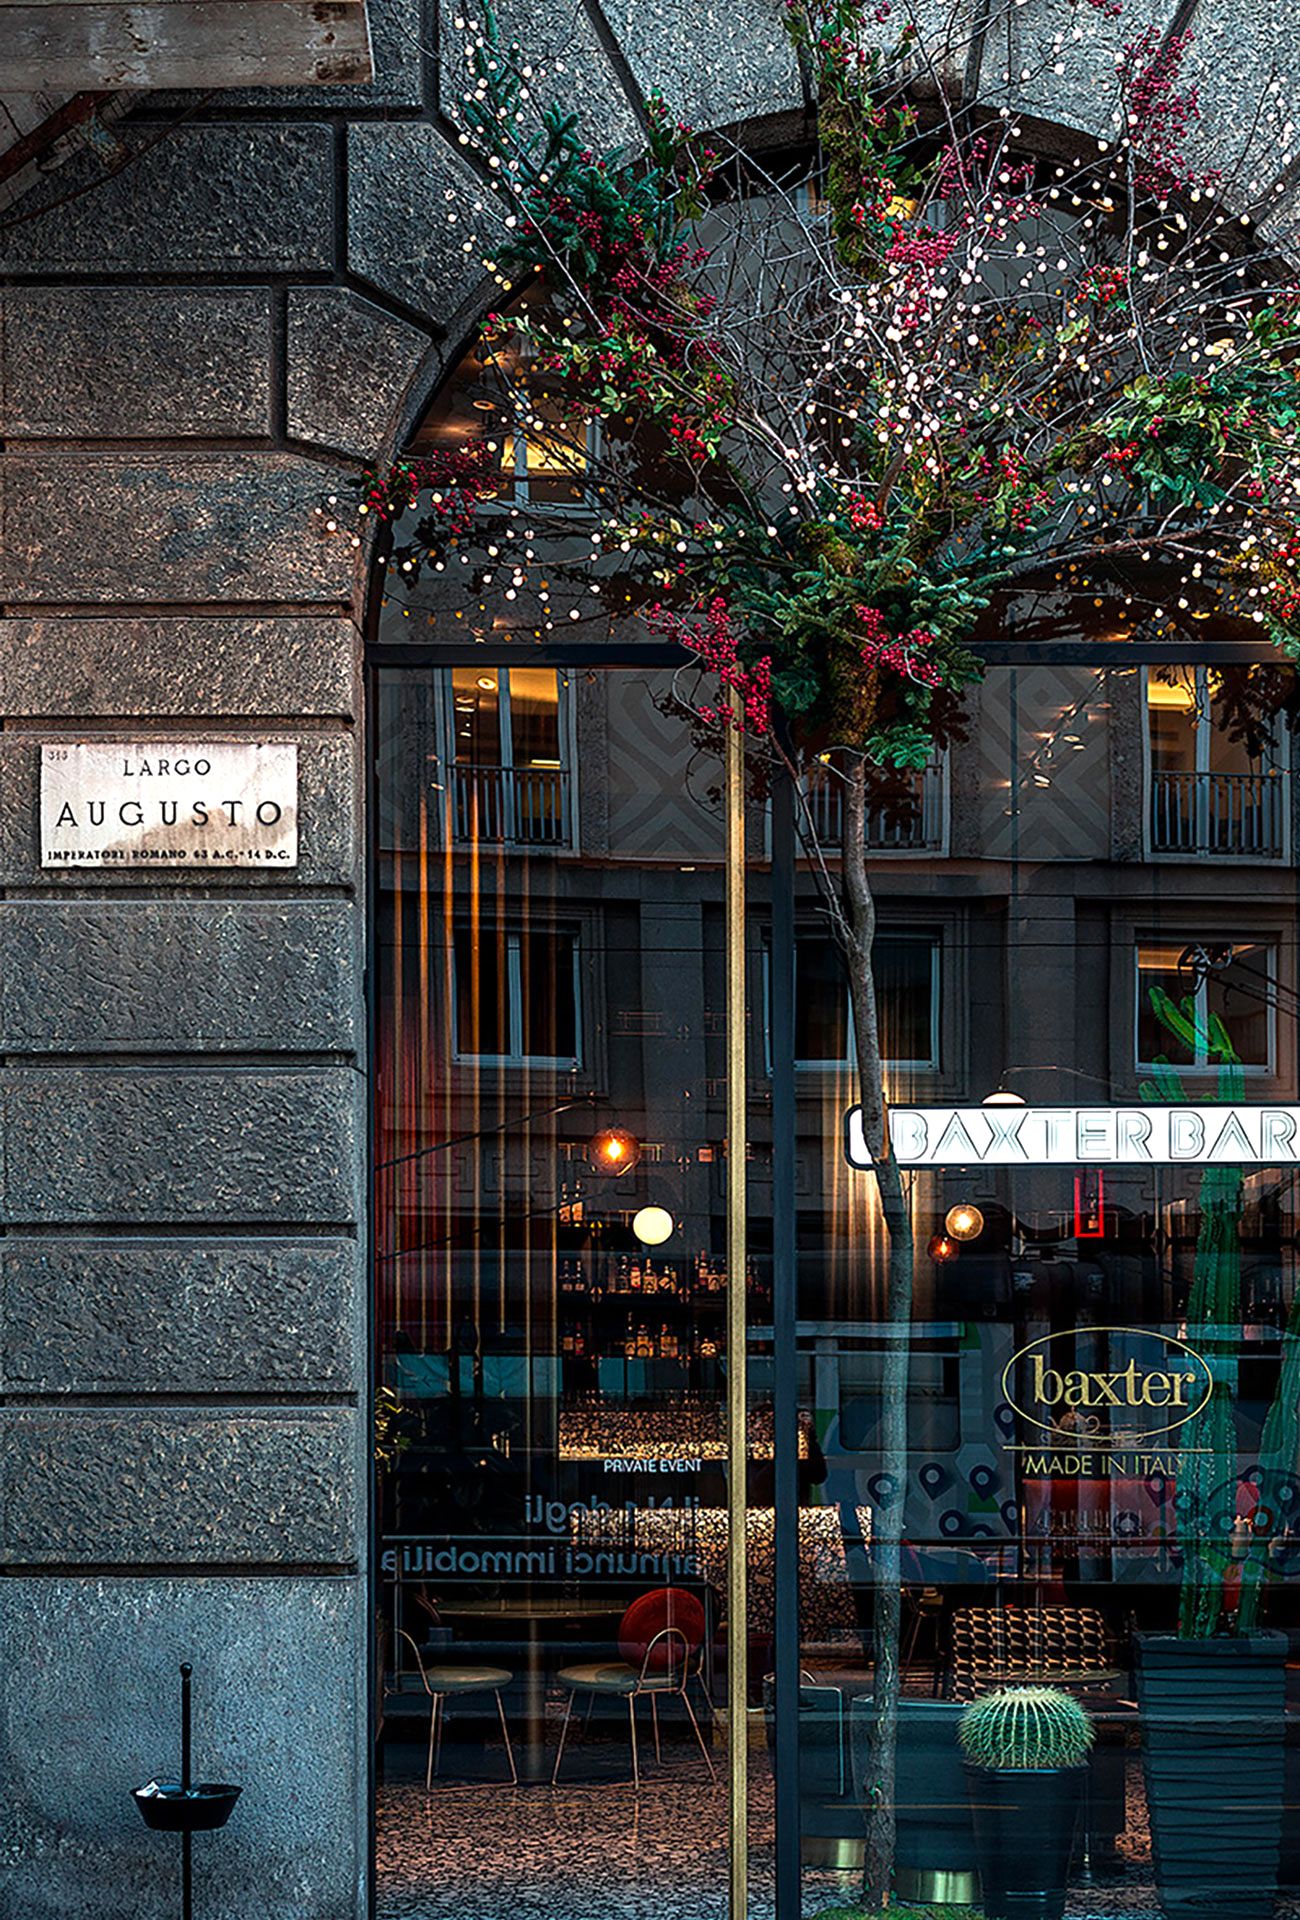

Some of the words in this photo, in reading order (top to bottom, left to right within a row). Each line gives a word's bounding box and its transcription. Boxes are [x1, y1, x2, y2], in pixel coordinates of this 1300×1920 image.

[123, 758, 211, 777] LARGO
[55, 800, 282, 828] AUGUSTO
[48, 850, 125, 860] IMPERATORE
[132, 850, 187, 859] ROMANO
[193, 850, 208, 859] 63
[247, 850, 261, 859] 14
[265, 850, 290, 859] D.C.
[891, 1110, 1153, 1160] BAXTER
[1168, 1110, 1298, 1160] BAR
[1028, 1354, 1196, 1407] baxter
[603, 1459, 657, 1473] PRIVATE
[660, 1459, 702, 1473] EVENT
[1024, 1454, 1093, 1475] MADE
[1101, 1454, 1127, 1476] IN
[1135, 1455, 1188, 1476] ITALY
